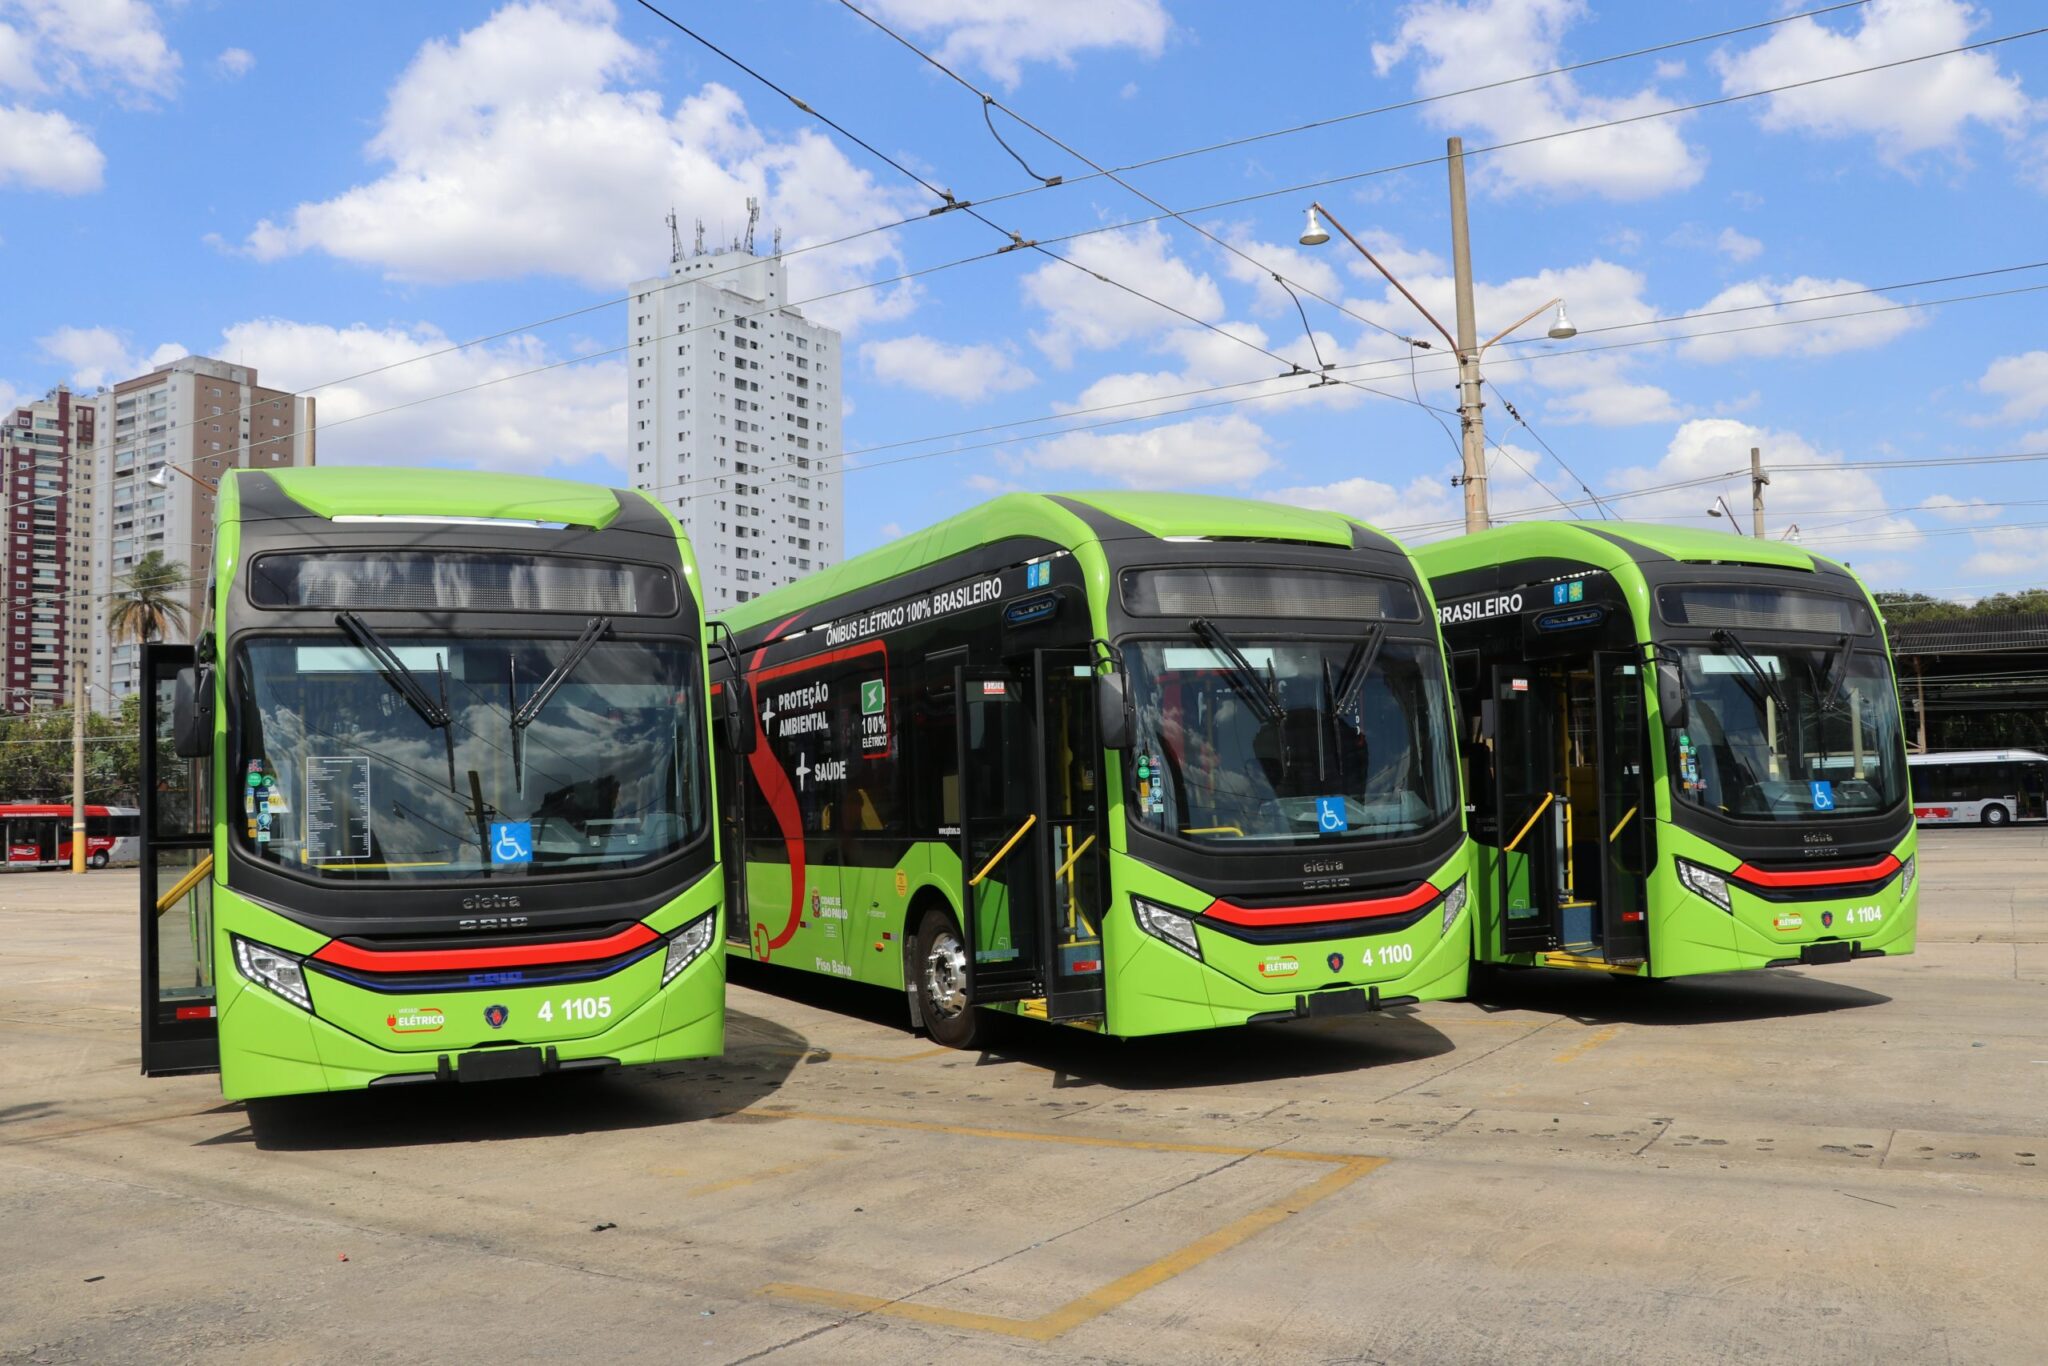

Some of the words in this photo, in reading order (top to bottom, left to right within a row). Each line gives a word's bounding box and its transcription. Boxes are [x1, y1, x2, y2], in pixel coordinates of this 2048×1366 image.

[826, 622, 857, 646] ÔNIBUS
[859, 606, 904, 637] ELÉTRICO
[906, 598, 931, 623] 100%
[933, 577, 1002, 615] BRASILEIRO
[1436, 594, 1523, 625] BRASILEIRO
[778, 681, 829, 711] PROTEÇÃO
[779, 711, 829, 737] AMBIENTAL
[861, 715, 887, 735] 100%
[862, 735, 887, 748] ELÉTRICO
[814, 757, 847, 781] SAÚDE
[1846, 909, 1855, 924] 4
[1857, 905, 1882, 923] 1104
[815, 957, 831, 972] Piso
[831, 959, 852, 977] Baixo
[1266, 959, 1299, 972] ELÉTRICO
[1362, 948, 1374, 967] 4
[1379, 944, 1413, 965] 1100
[398, 1014, 445, 1026] ELÉTRICO
[537, 1000, 553, 1022] 4
[561, 997, 612, 1020] 1105
